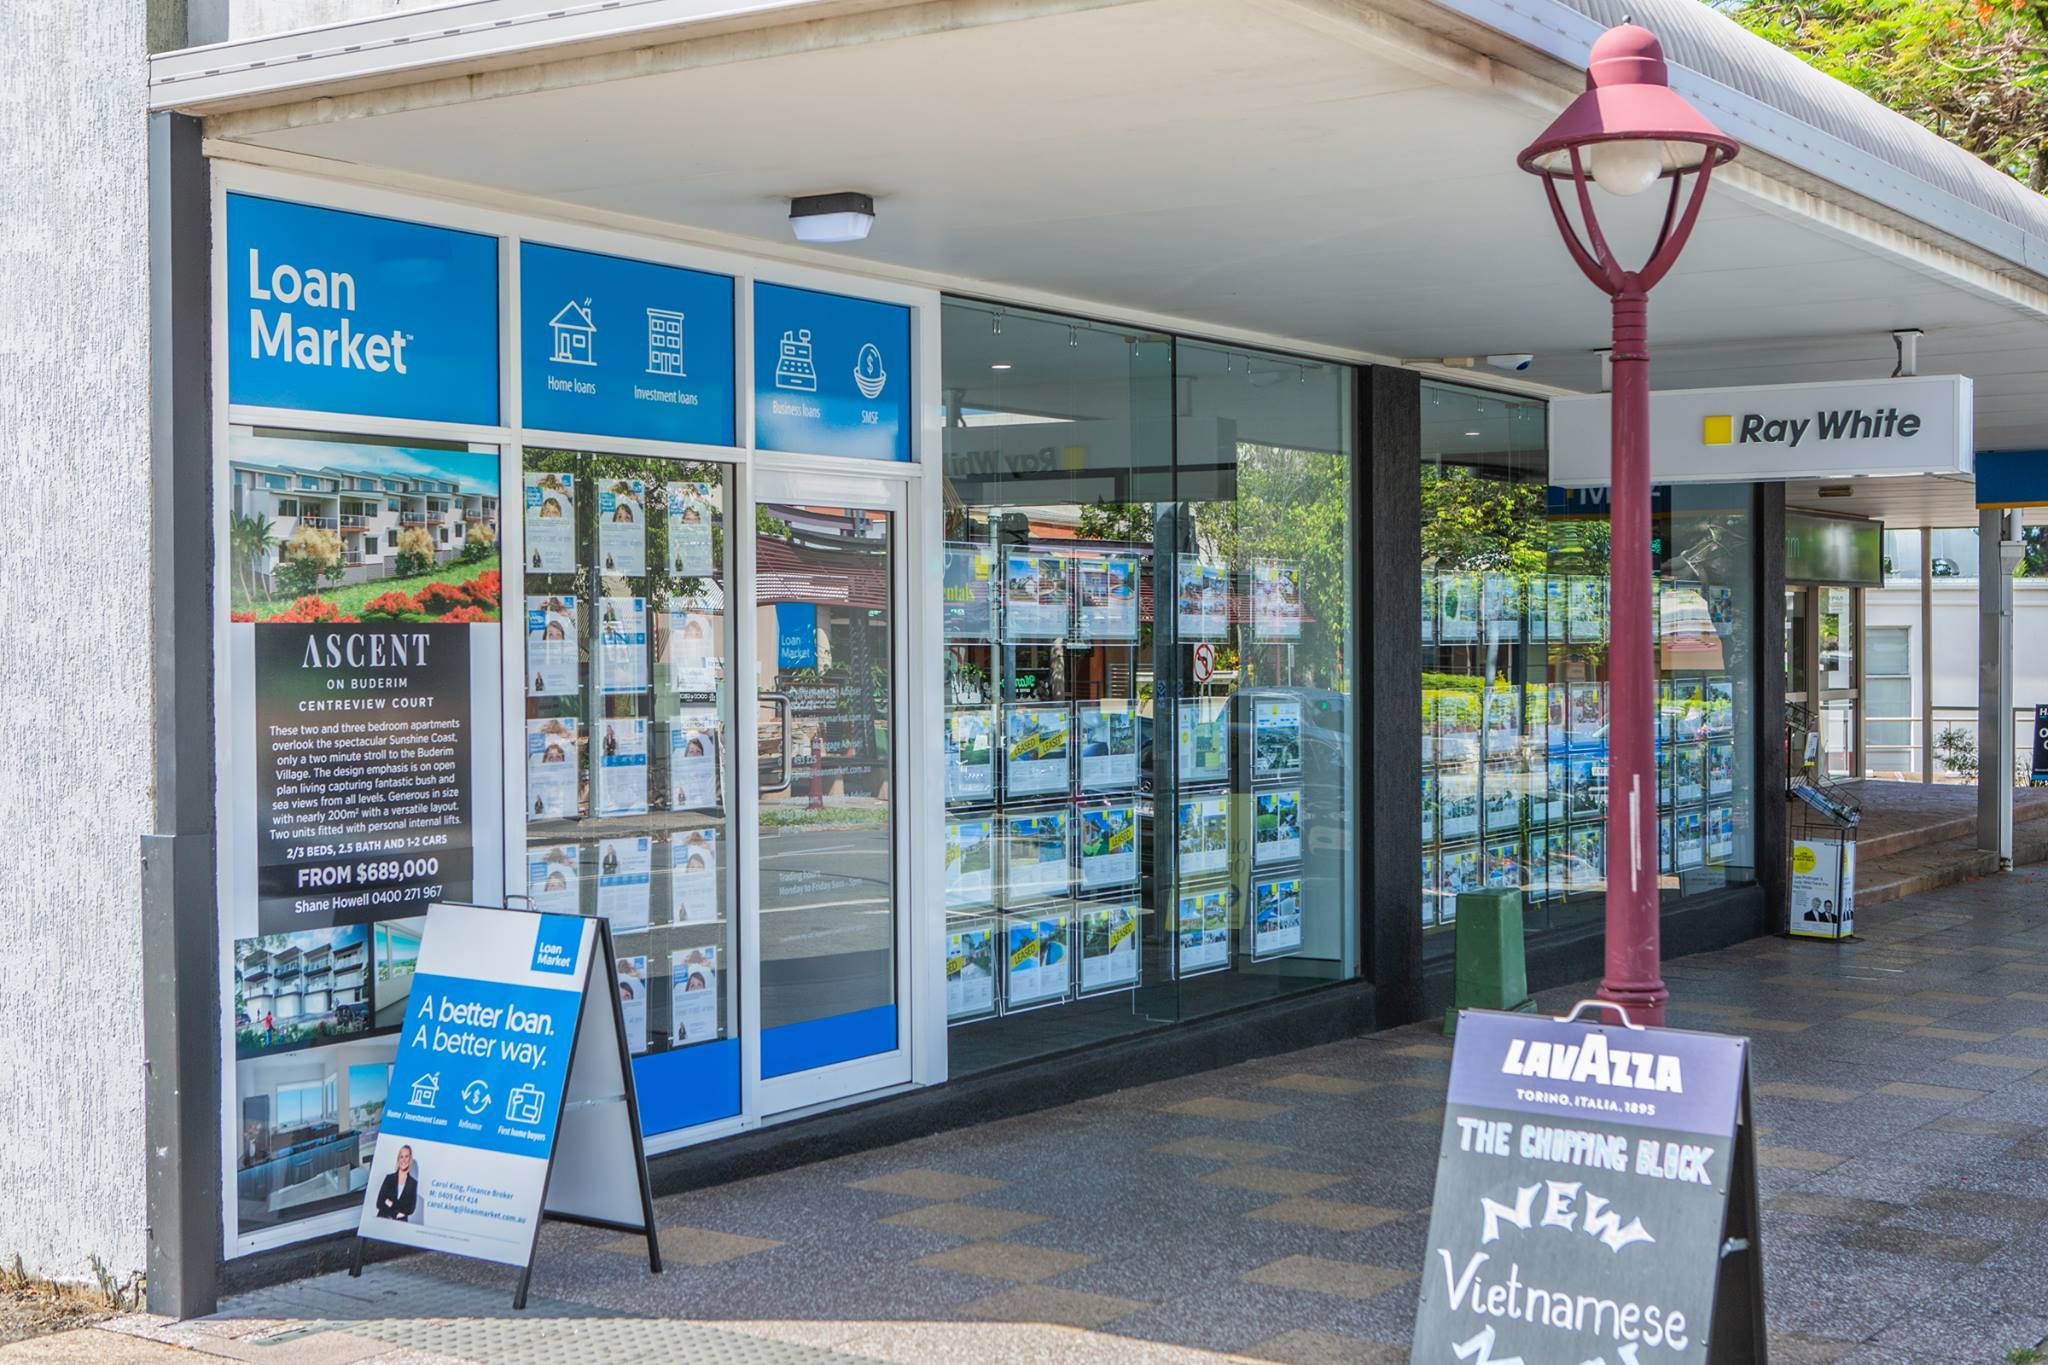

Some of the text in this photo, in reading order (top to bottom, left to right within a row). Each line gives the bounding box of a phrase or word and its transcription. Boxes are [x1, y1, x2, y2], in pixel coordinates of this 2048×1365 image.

[250, 248, 355, 311] Loan
[250, 309, 407, 374] Market
[548, 375, 596, 394] Home loans
[634, 385, 698, 405] Investment loans
[802, 403, 820, 418] loans
[1739, 408, 1920, 447] Ray White
[302, 633, 430, 668] ASCENT
[781, 634, 800, 646] Loan
[327, 678, 408, 689] ON BUDERIM
[299, 697, 434, 712] CENTREVIEW COURT
[270, 719, 460, 737] These two and three bedroom apartments
[272, 733, 458, 751] overlook the spectacular Sunshine Coast,
[277, 747, 454, 766] only a two minute stroll to the Buderim
[276, 762, 455, 781] Village. The design emphasis is on open
[277, 774, 455, 796] plan living capturing fantastic bush and
[272, 788, 459, 811] sea views from all levels. Generous in size
[273, 814, 293, 825] with
[297, 812, 325, 824] nearly
[362, 806, 381, 817] with
[383, 808, 389, 816] a
[392, 803, 428, 815] versatile
[430, 801, 459, 813] layout.
[269, 815, 462, 840] Two units fitted with personal internal lifts.
[287, 834, 448, 860] 2/3 BEDS, 2.5 BATH AND 1-2 CARS
[298, 857, 438, 888] FROM $689,000
[295, 885, 443, 914] Shane Howell 0400 271 967
[539, 942, 562, 955] Loan
[537, 954, 571, 968] Market
[418, 995, 554, 1036] A better loan.
[412, 1024, 547, 1070] A better way.
[1502, 1033, 1683, 1093] LAVAZZA
[1624, 1101, 1656, 1116] 1895
[498, 1125, 511, 1136] First
[1457, 1117, 1715, 1186] THE CHOPPING BLOCK
[1481, 1179, 1656, 1253] NEW
[1437, 1249, 1689, 1351] Vietnamese
